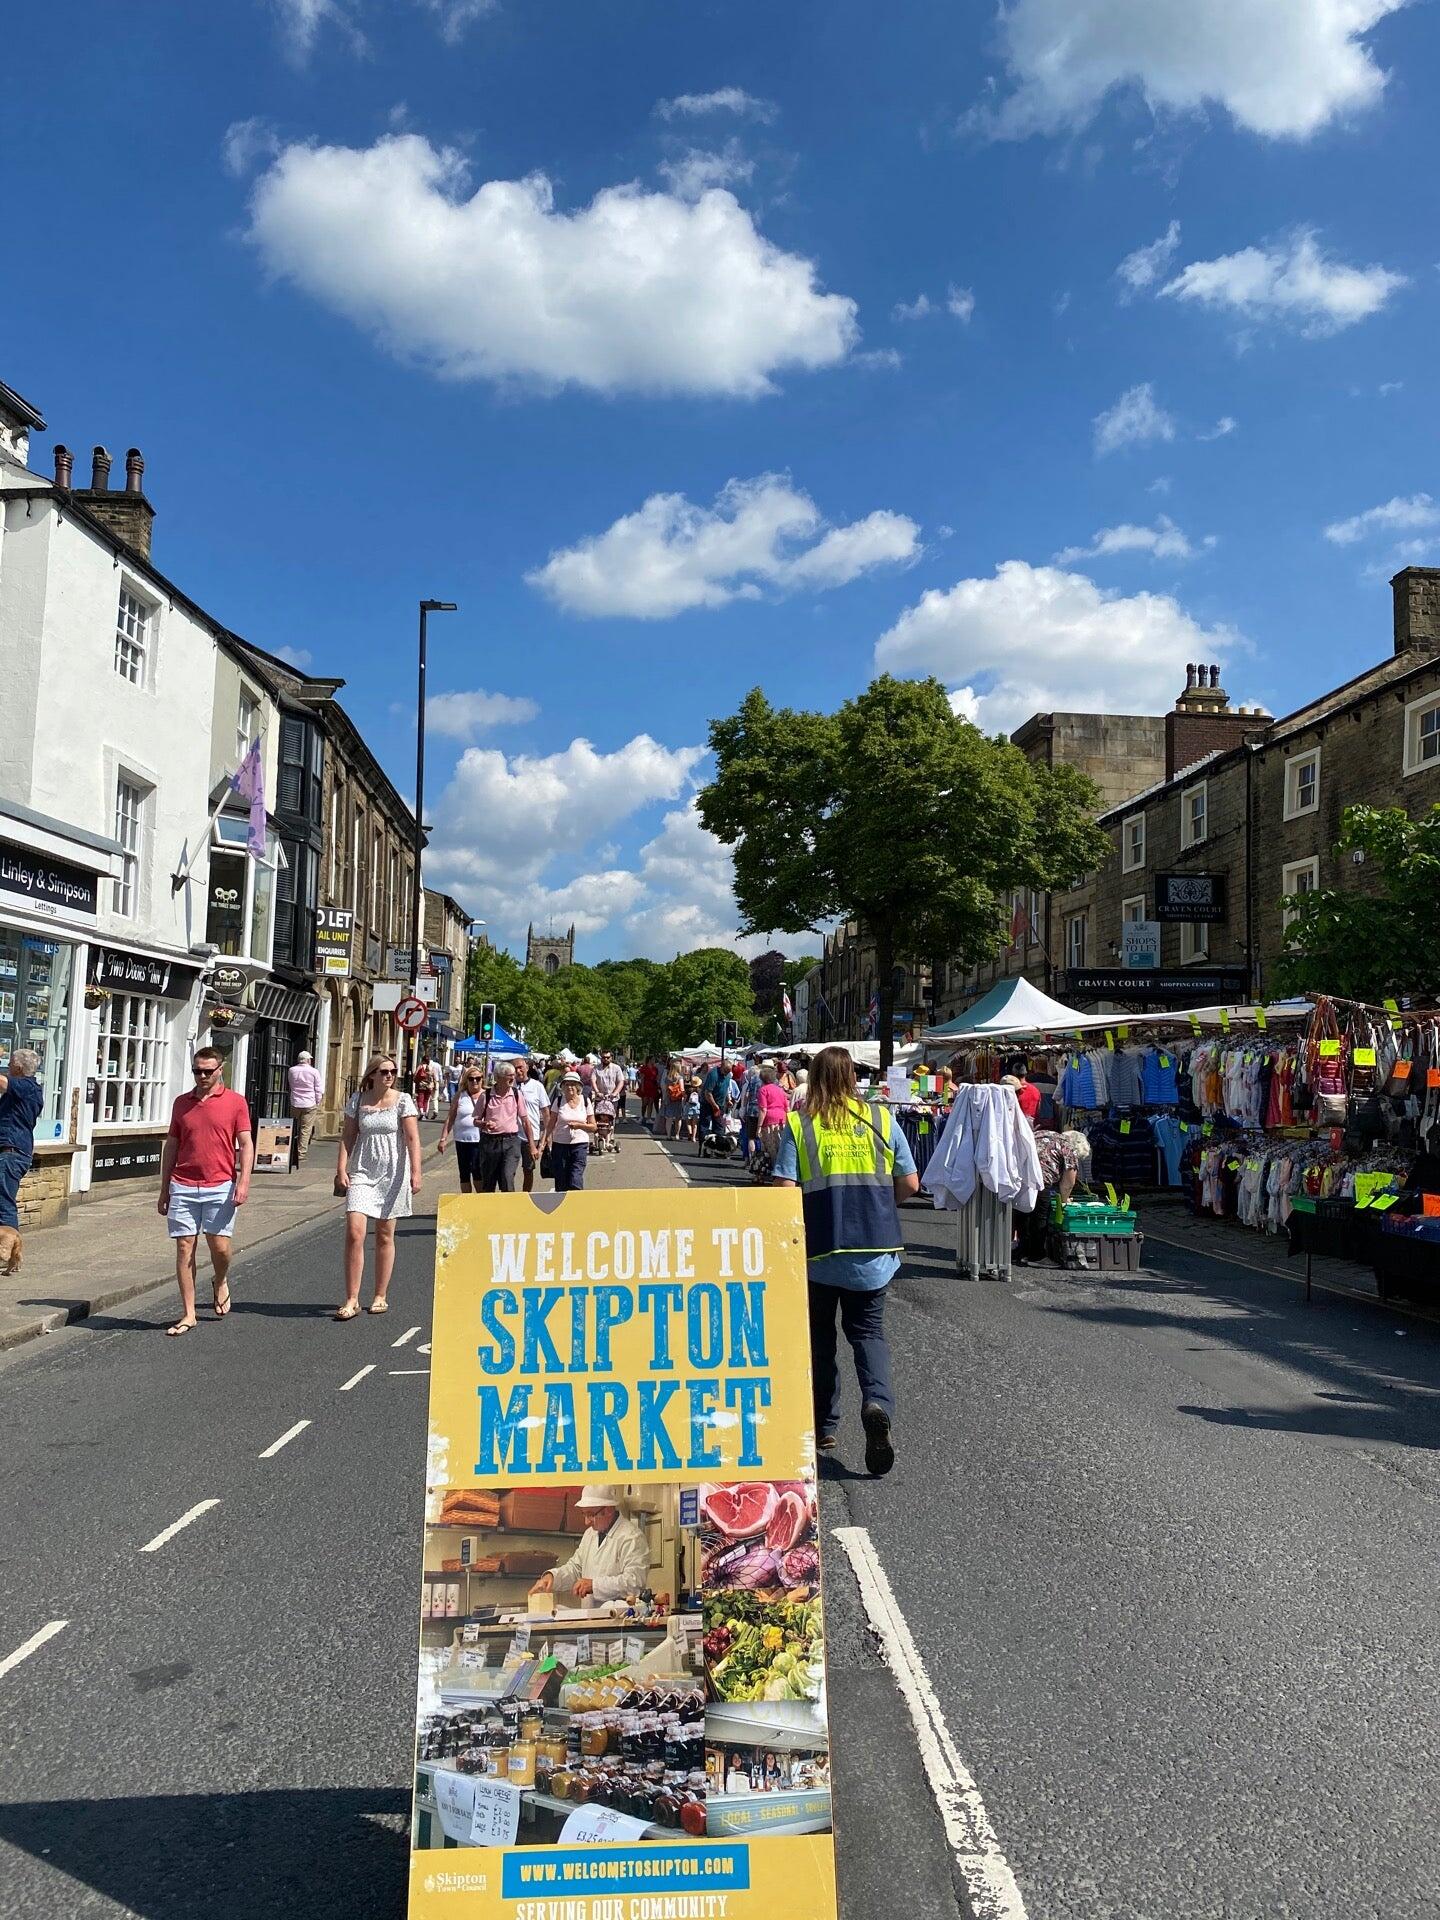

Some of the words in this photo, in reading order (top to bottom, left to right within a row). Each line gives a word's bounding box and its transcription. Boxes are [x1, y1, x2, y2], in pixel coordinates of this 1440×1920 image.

[1, 857, 34, 890] Linley
[36, 869, 45, 889] &
[47, 872, 91, 903] Simpson
[34, 900, 57, 914] Lettings
[1158, 905, 1192, 913] CRAVEN
[1193, 905, 1221, 913] COURT
[316, 909, 326, 926] O
[328, 910, 352, 929] LET
[332, 932, 350, 942] UNIT
[1126, 937, 1157, 945] SHOPS
[317, 946, 346, 956] ENQUIRIES
[393, 949, 412, 957] Shee
[393, 957, 412, 965] Stre
[1078, 979, 1116, 987] CRAVEN
[1118, 979, 1152, 987] COURT
[824, 1143, 843, 1151] TOWN
[843, 1143, 870, 1151] CENTRE
[825, 1150, 870, 1158] MANAGEMENT
[488, 1228, 696, 1283] WELCOME
[712, 1227, 765, 1277] TO
[477, 1281, 770, 1376] SKIPTON
[474, 1377, 773, 1475] MARKET
[520, 1857, 734, 1882] WWW.WELCOMETOSKIPTON.COM
[436, 1872, 487, 1888] Skipton
[435, 1885, 457, 1893] Town
[462, 1884, 487, 1892] Council
[515, 1900, 587, 1920] SERVING
[592, 1899, 624, 1920] OUR
[630, 1894, 728, 1920] COMMUNITY
